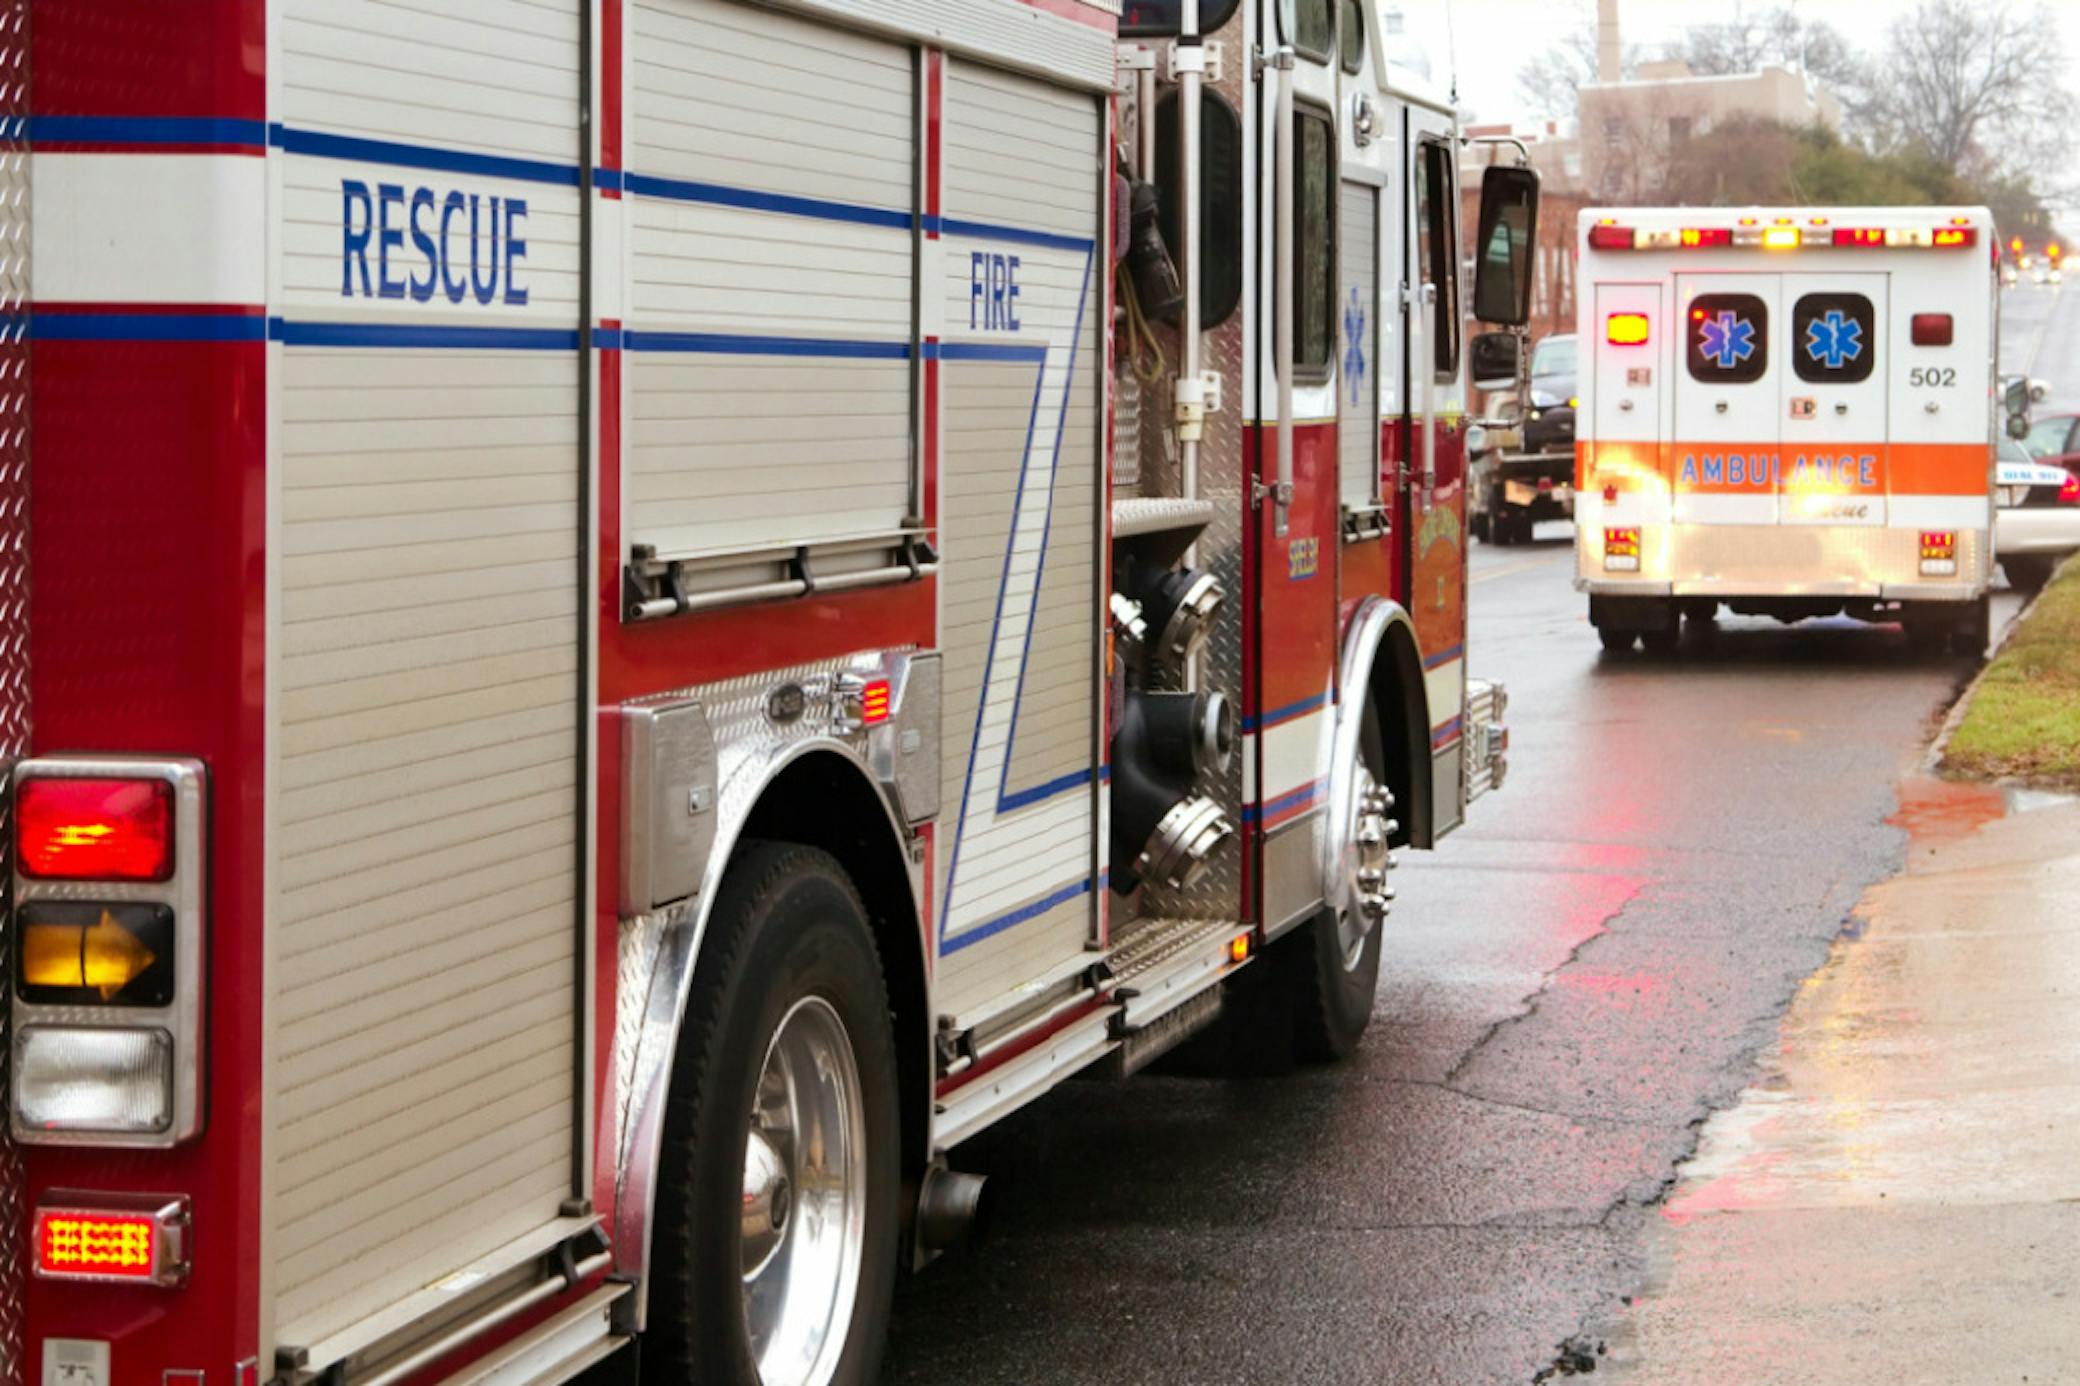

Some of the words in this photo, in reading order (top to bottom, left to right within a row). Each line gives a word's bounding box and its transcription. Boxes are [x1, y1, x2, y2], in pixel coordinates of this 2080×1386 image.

[342, 179, 528, 305] RESCUE
[970, 252, 1020, 331] FIRE
[1909, 367, 1957, 388] 502
[1679, 454, 1877, 486] AMBULANCE
